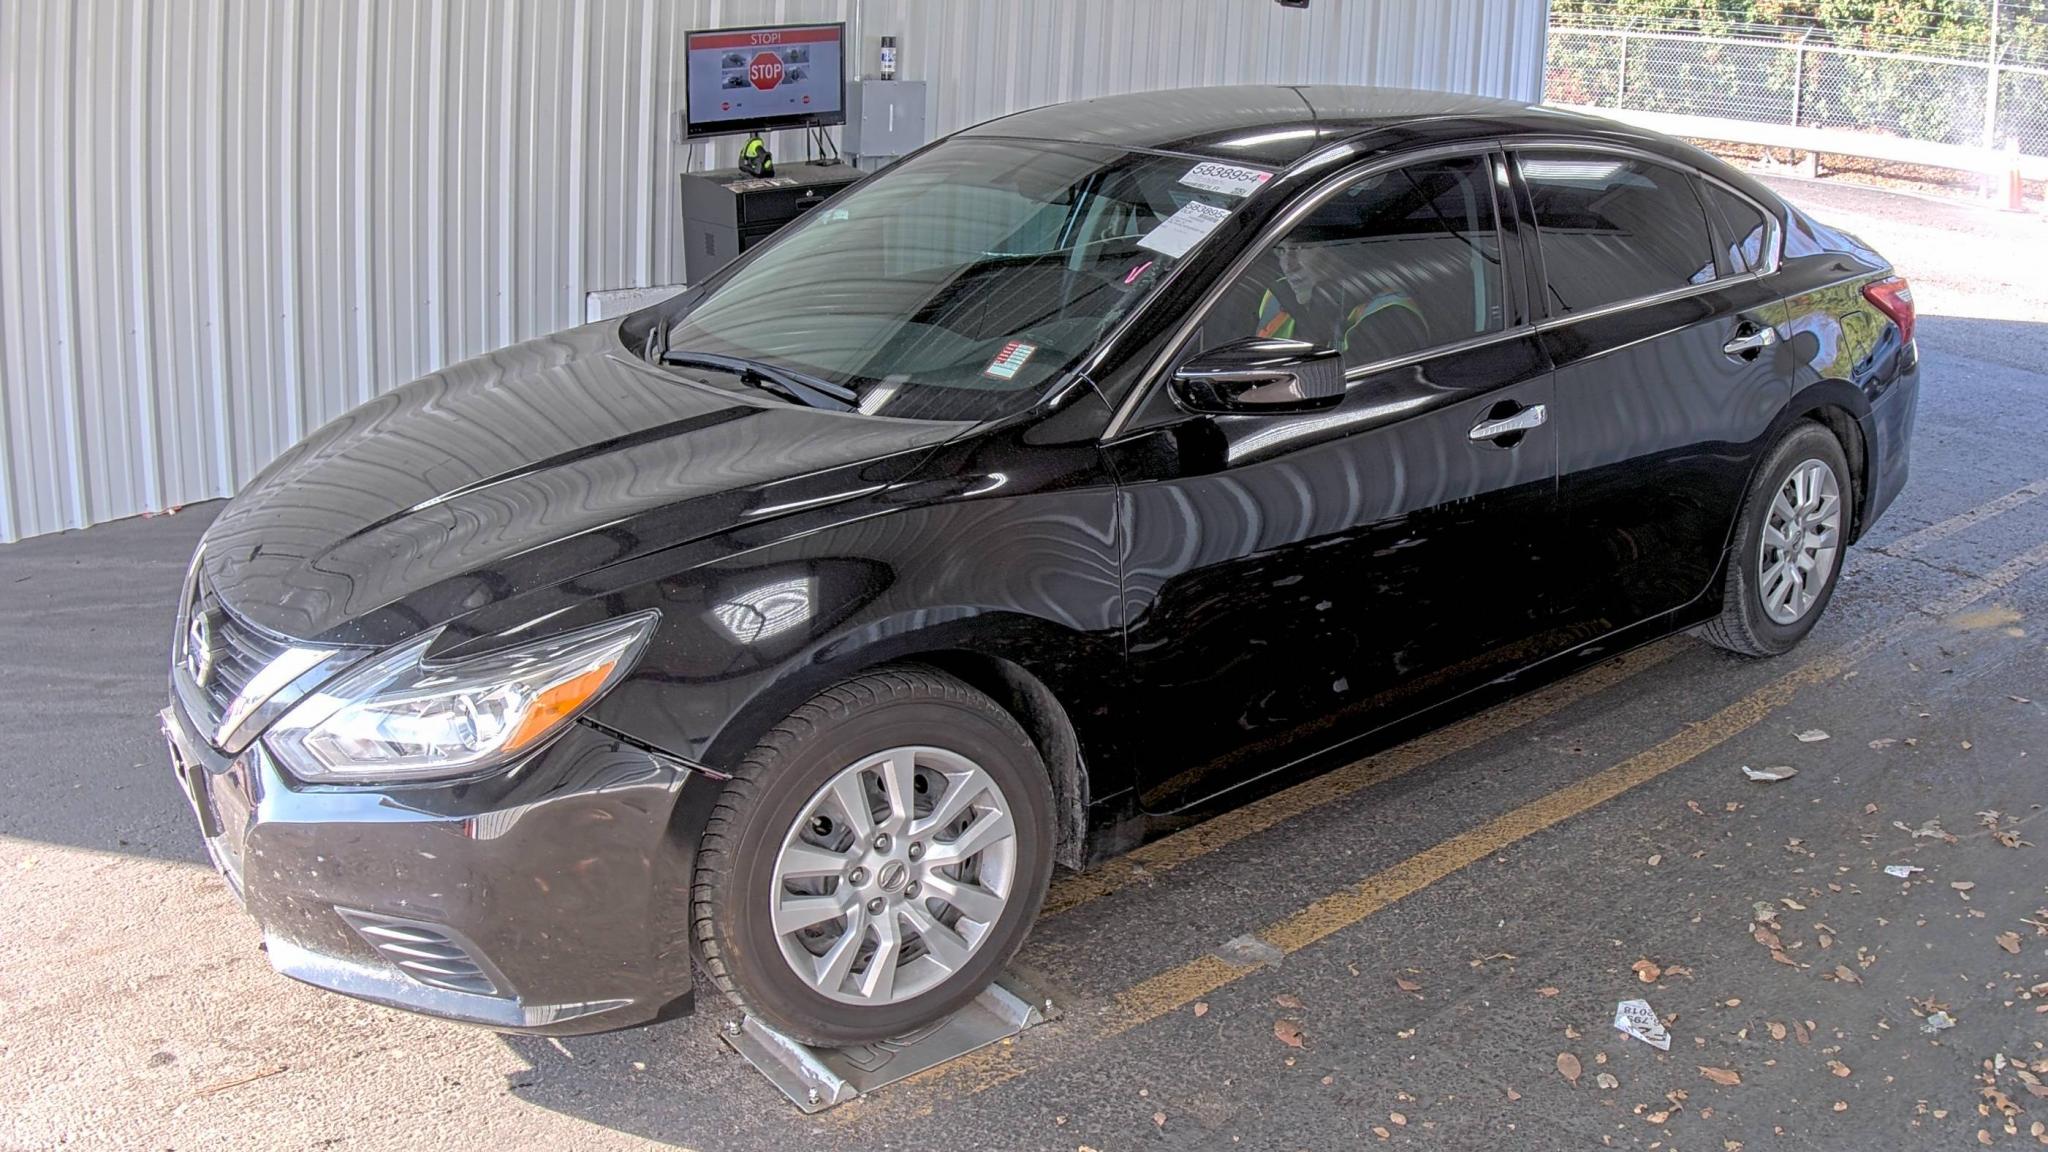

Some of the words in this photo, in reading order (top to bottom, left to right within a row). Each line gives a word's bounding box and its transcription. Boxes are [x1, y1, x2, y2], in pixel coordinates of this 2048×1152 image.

[750, 32, 782, 45] STOP!
[751, 63, 782, 80] STOP
[1192, 164, 1261, 184] 5838954
[1624, 1006, 1653, 1017] 2018
